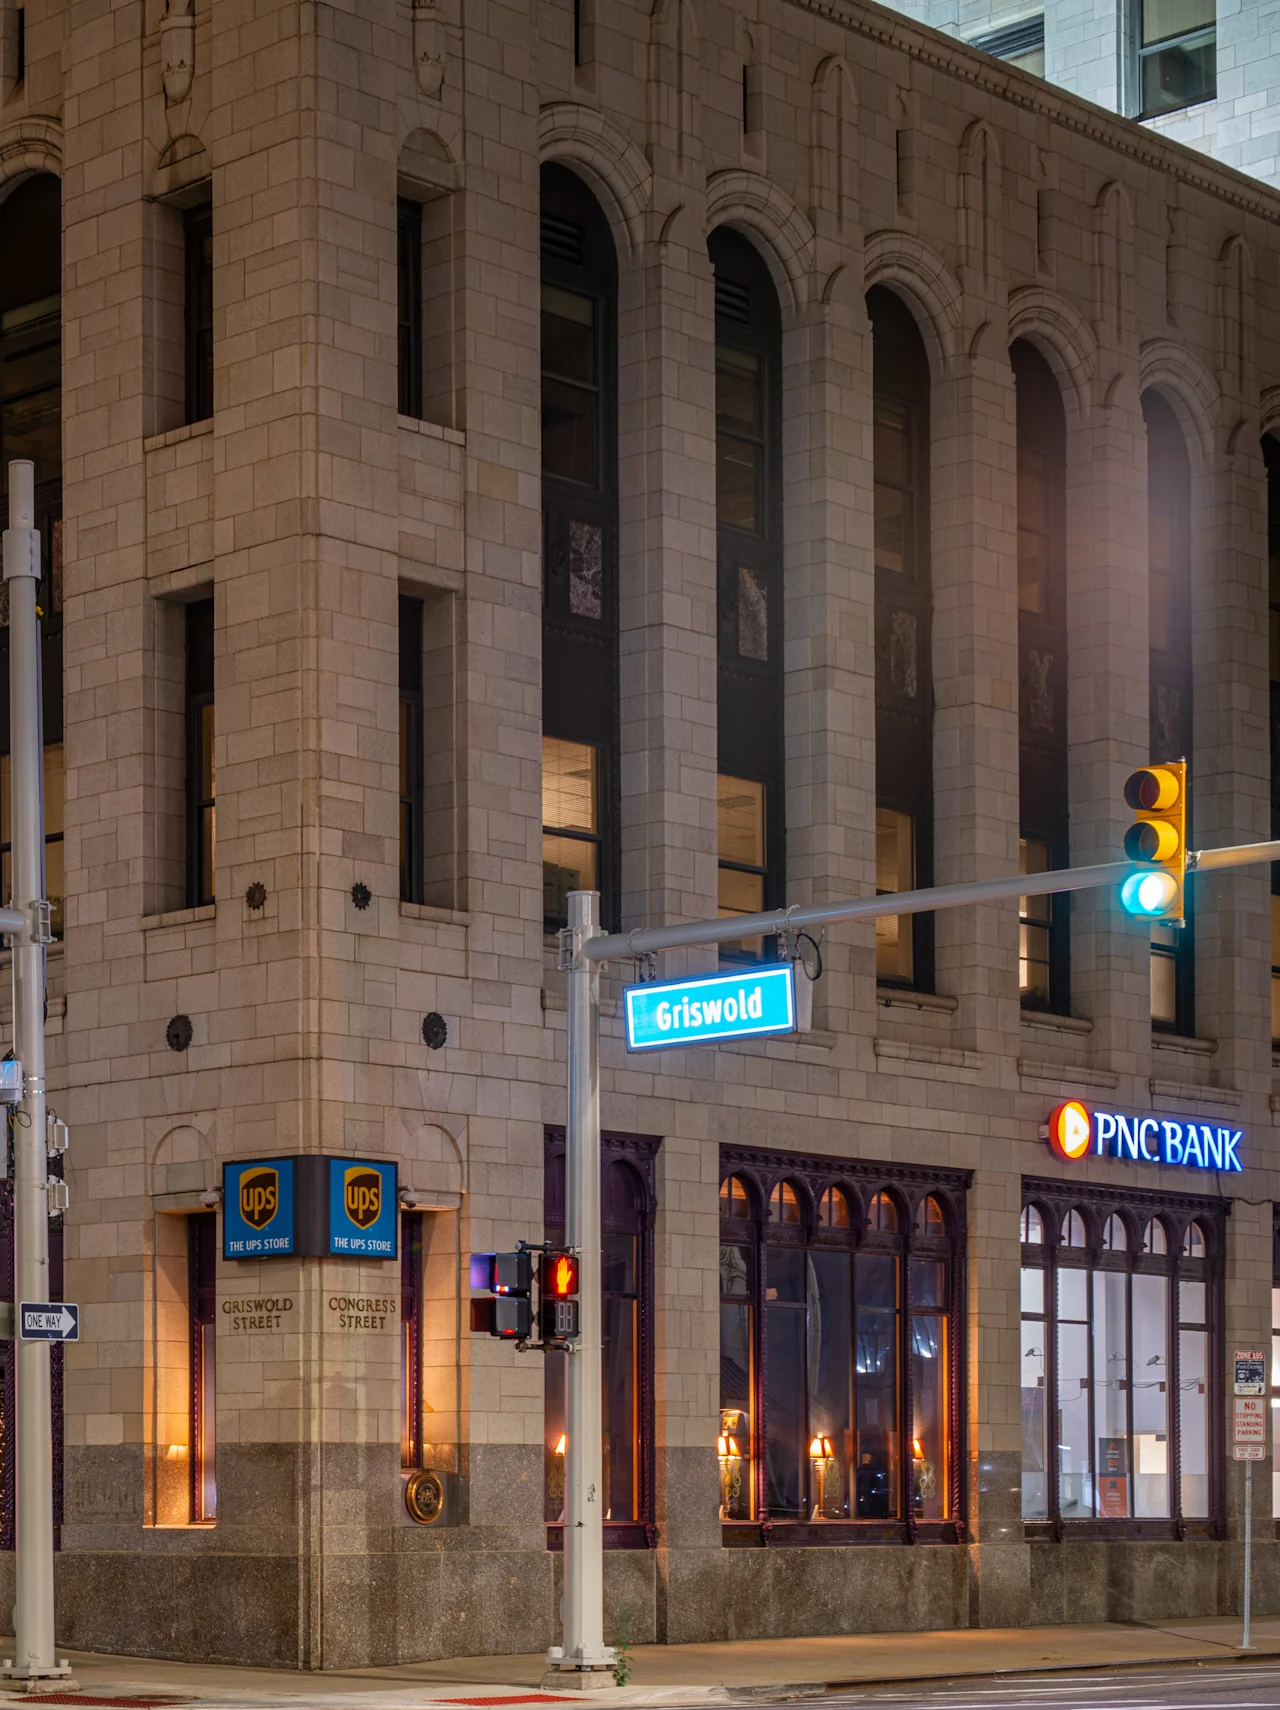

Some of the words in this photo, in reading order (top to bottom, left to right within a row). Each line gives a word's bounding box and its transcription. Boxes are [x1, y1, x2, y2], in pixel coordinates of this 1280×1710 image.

[656, 986, 763, 1031] Griswold
[1094, 1112, 1159, 1162] PNC
[1161, 1121, 1243, 1172] BANK
[242, 1186, 276, 1220] ups
[347, 1185, 379, 1220] ups
[229, 1241, 244, 1252] THE
[245, 1239, 262, 1251] UPS
[264, 1237, 290, 1249] STORE
[334, 1237, 349, 1248] THE
[350, 1238, 366, 1250] UPS
[367, 1240, 391, 1252] STORE
[222, 1298, 293, 1314] GRISWOLD
[329, 1297, 396, 1313] CONGRESS
[26, 1315, 45, 1328] ONE
[45, 1316, 62, 1328] WAY
[233, 1315, 282, 1330] STREET
[339, 1315, 386, 1330] STREET
[1236, 1352, 1251, 1360] ZONE
[1252, 1352, 1263, 1360] 105
[1244, 1402, 1256, 1410] NO
